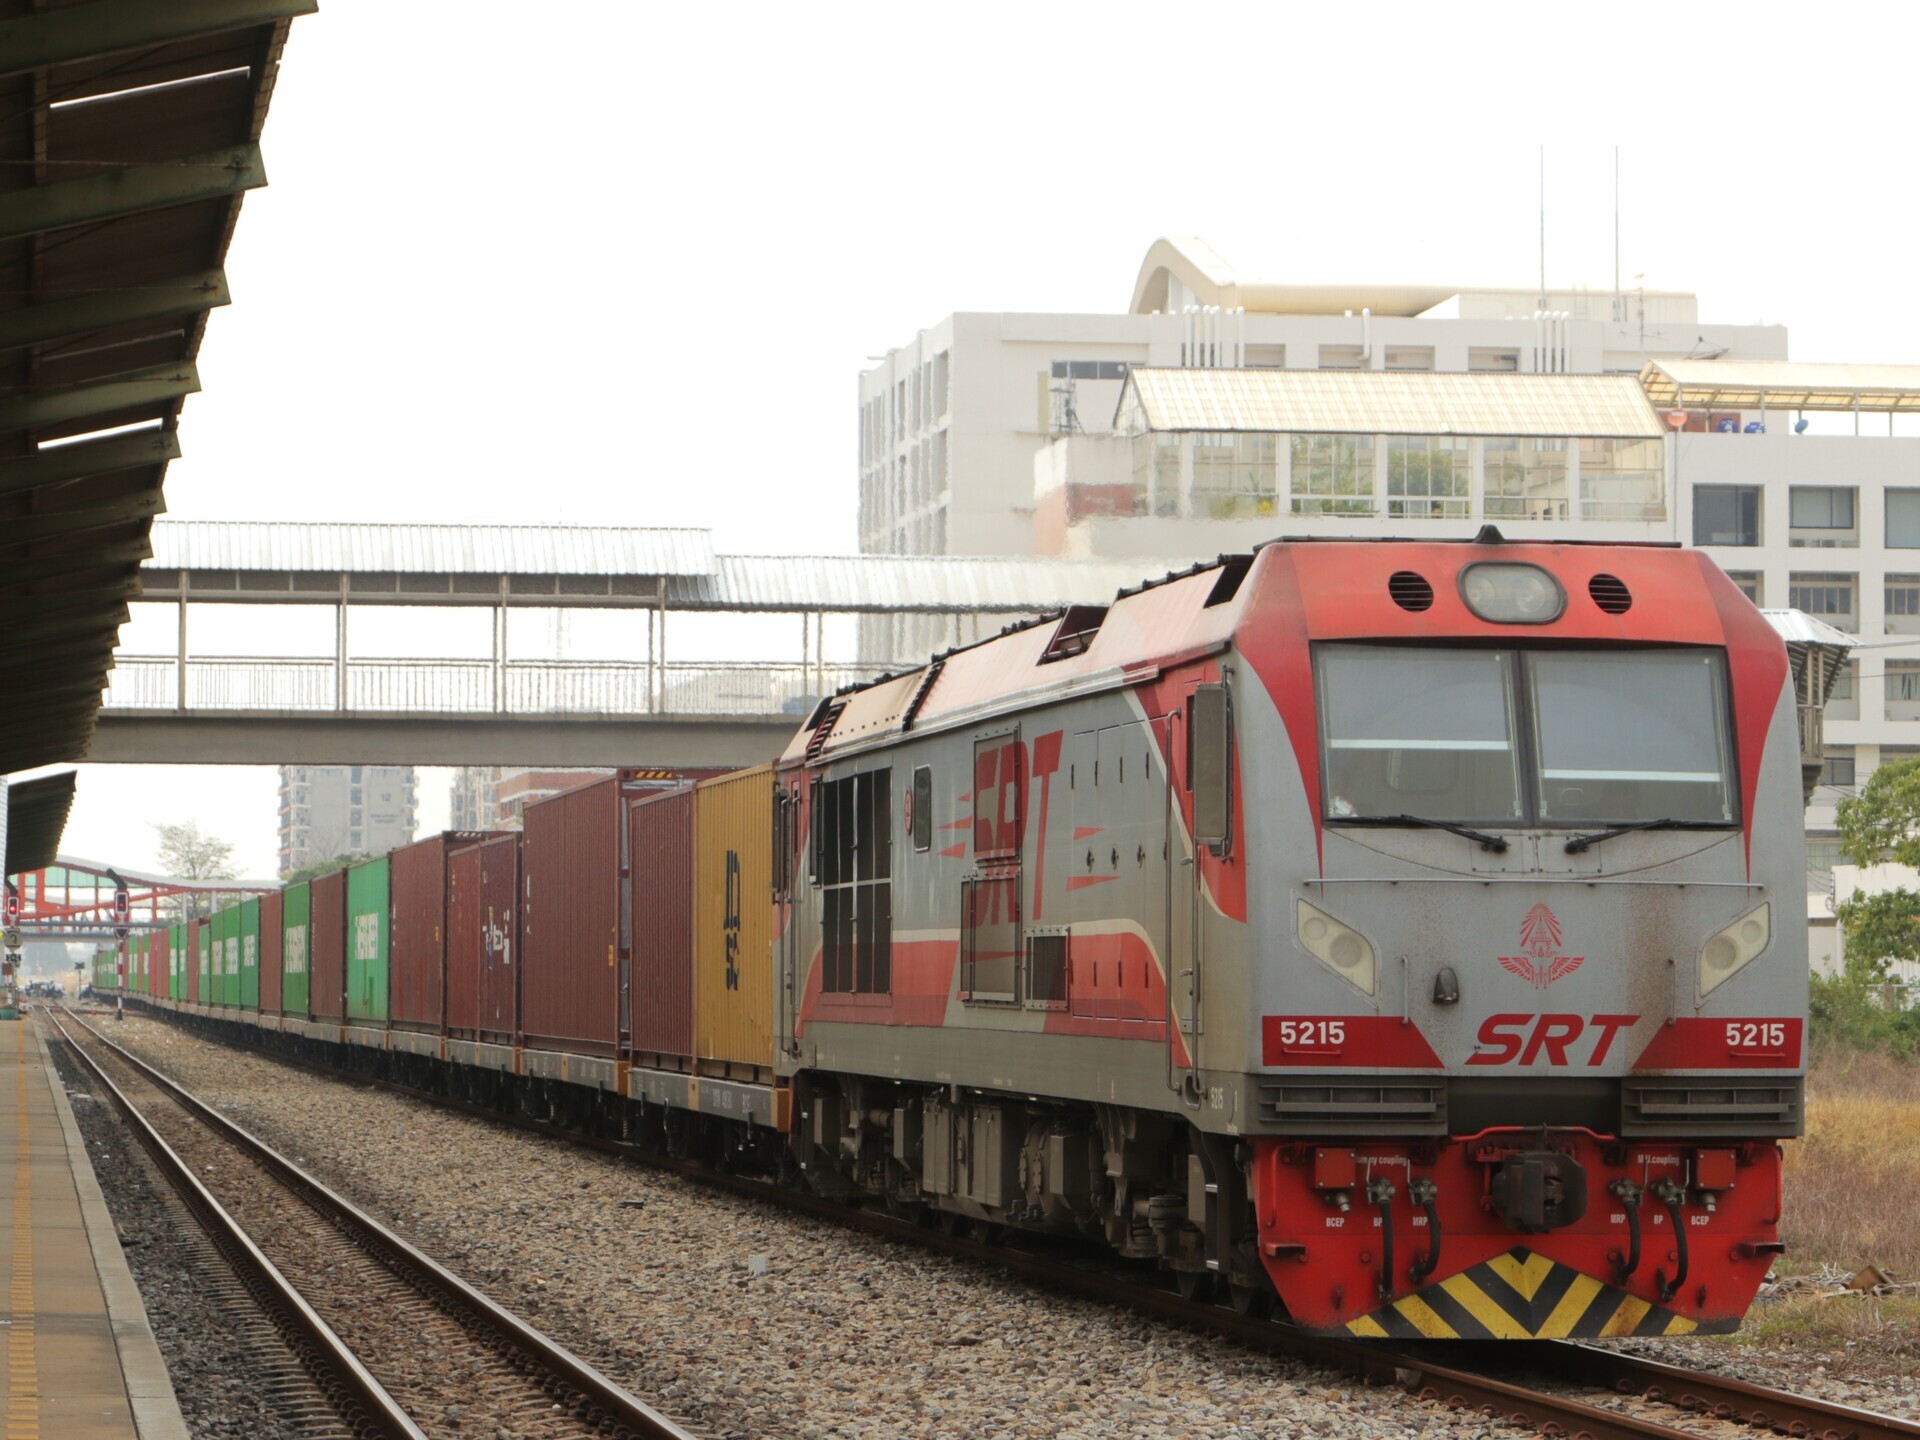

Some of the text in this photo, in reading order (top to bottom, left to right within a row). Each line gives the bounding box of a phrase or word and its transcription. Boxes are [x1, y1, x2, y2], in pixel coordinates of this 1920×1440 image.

[1280, 1021, 1345, 1045] 5215
[1726, 1023, 1785, 1046] 5215
[1464, 1013, 1641, 1066] SRT
[1379, 1155, 1407, 1167] coupling
[1326, 1217, 1345, 1228] BCEP
[1373, 1217, 1383, 1228] BP
[1412, 1216, 1428, 1227] MRP
[1610, 1214, 1625, 1224] MRP
[1653, 1215, 1664, 1225] BP
[1691, 1215, 1710, 1226] BCEP
